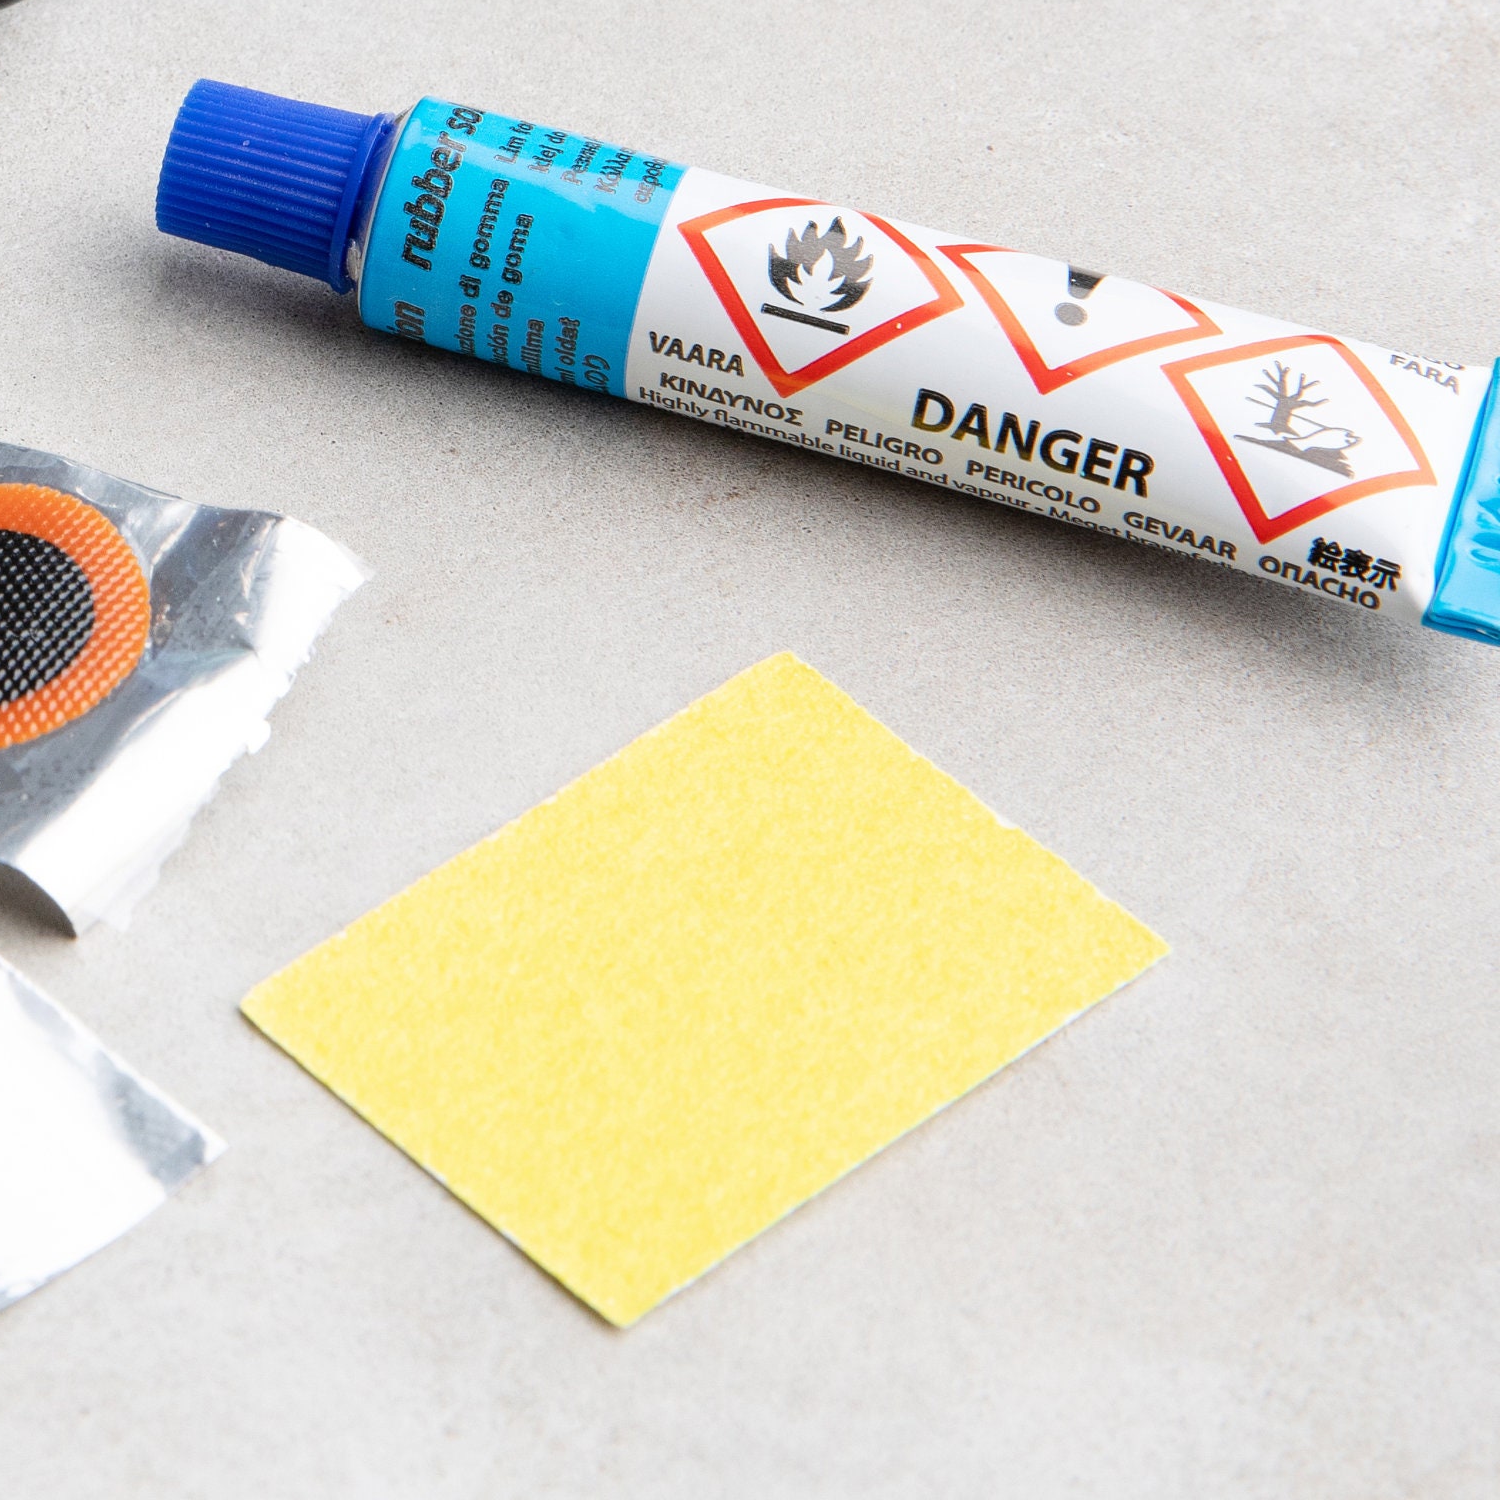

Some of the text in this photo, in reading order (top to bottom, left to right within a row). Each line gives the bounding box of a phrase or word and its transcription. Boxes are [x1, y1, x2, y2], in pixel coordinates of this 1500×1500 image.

[494, 136, 526, 164] Lim
[402, 131, 467, 272] rubber
[468, 178, 510, 270] gomma
[501, 213, 534, 285] goma
[458, 274, 482, 299] di
[490, 290, 514, 319] de
[554, 316, 581, 366] oldat
[648, 331, 745, 378] VAARA
[1390, 354, 1460, 396] FARA
[639, 386, 710, 418] Highly
[712, 408, 835, 454] flammable
[839, 443, 901, 472] liquid
[905, 465, 949, 486] and
[952, 479, 1031, 509] vapour
[910, 388, 1156, 498] DANGER
[825, 418, 944, 465] PELIGRO
[966, 459, 1102, 514] PERICOLO
[1123, 511, 1238, 561] GEVAAR
[1258, 555, 1381, 611] ОПАСНО
